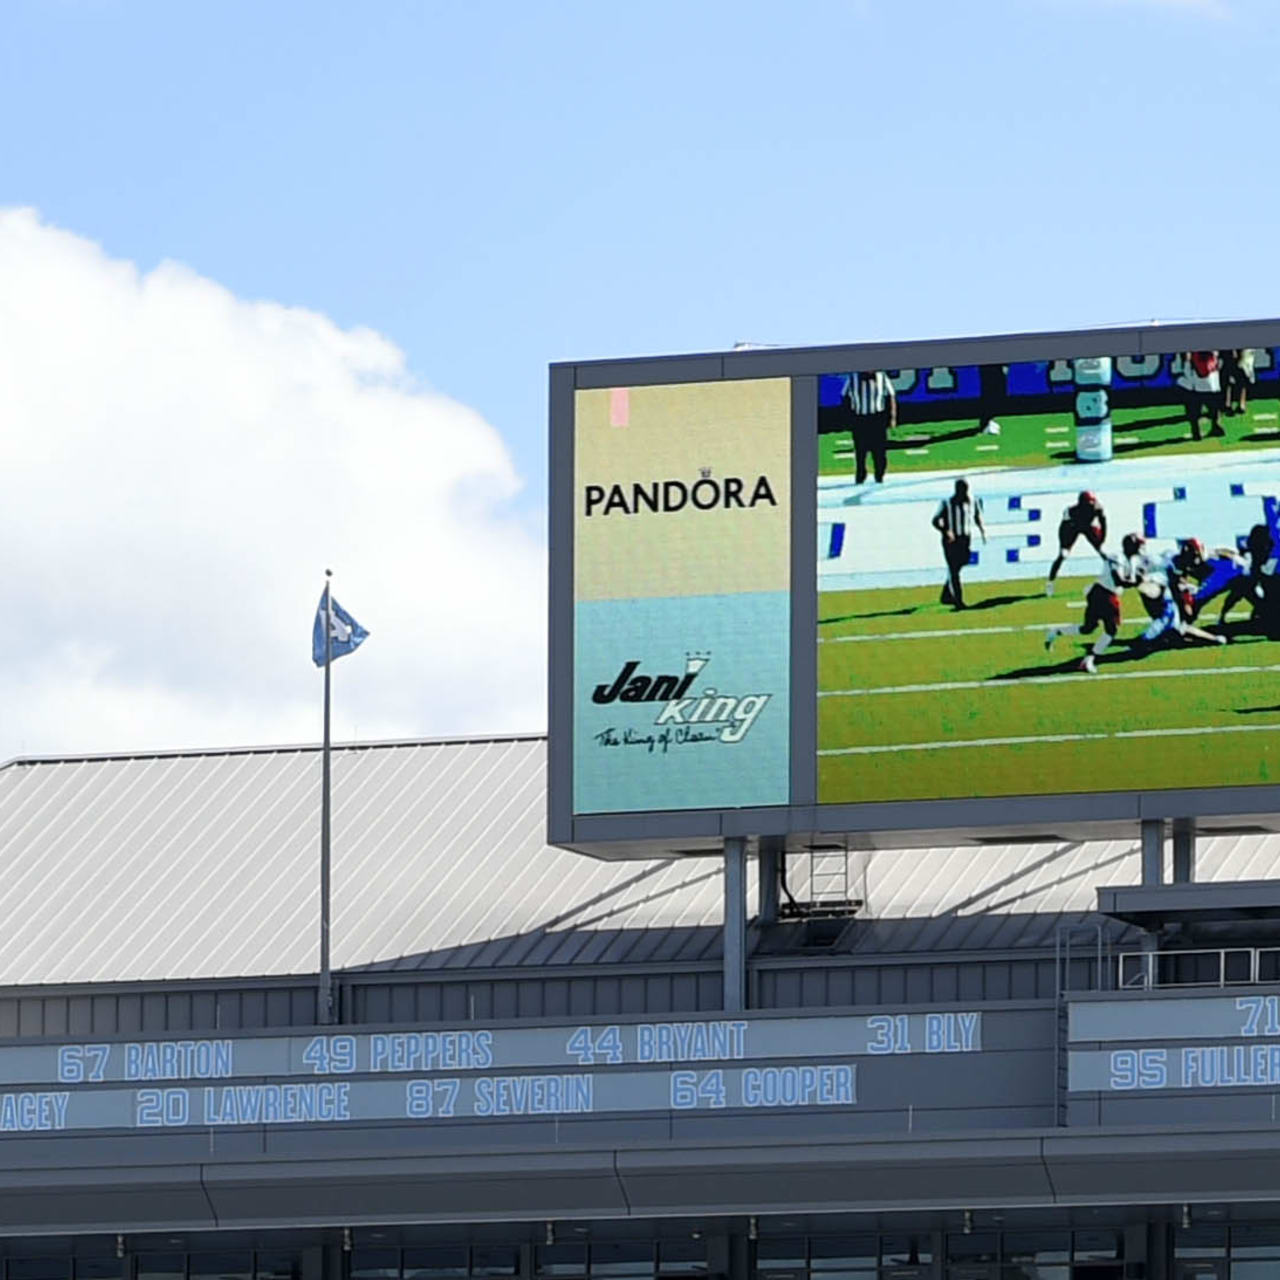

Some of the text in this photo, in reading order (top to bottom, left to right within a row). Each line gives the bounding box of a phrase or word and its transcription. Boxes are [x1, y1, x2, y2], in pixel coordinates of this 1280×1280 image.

[584, 474, 779, 517] PANDORA
[592, 655, 710, 705] Jani
[866, 1011, 981, 1054] 31 BLY
[1235, 996, 1280, 1037] 71
[58, 1040, 233, 1083] 67 BARTON
[302, 1030, 493, 1075] 49 PEPPERS
[566, 1020, 749, 1065] 44 BRYANT
[670, 1064, 856, 1109] 64 COOPER
[1110, 1050, 1168, 1090] 95
[136, 1082, 351, 1127] 20 LAWRENCE
[406, 1073, 594, 1118] 87 SEVERIN
